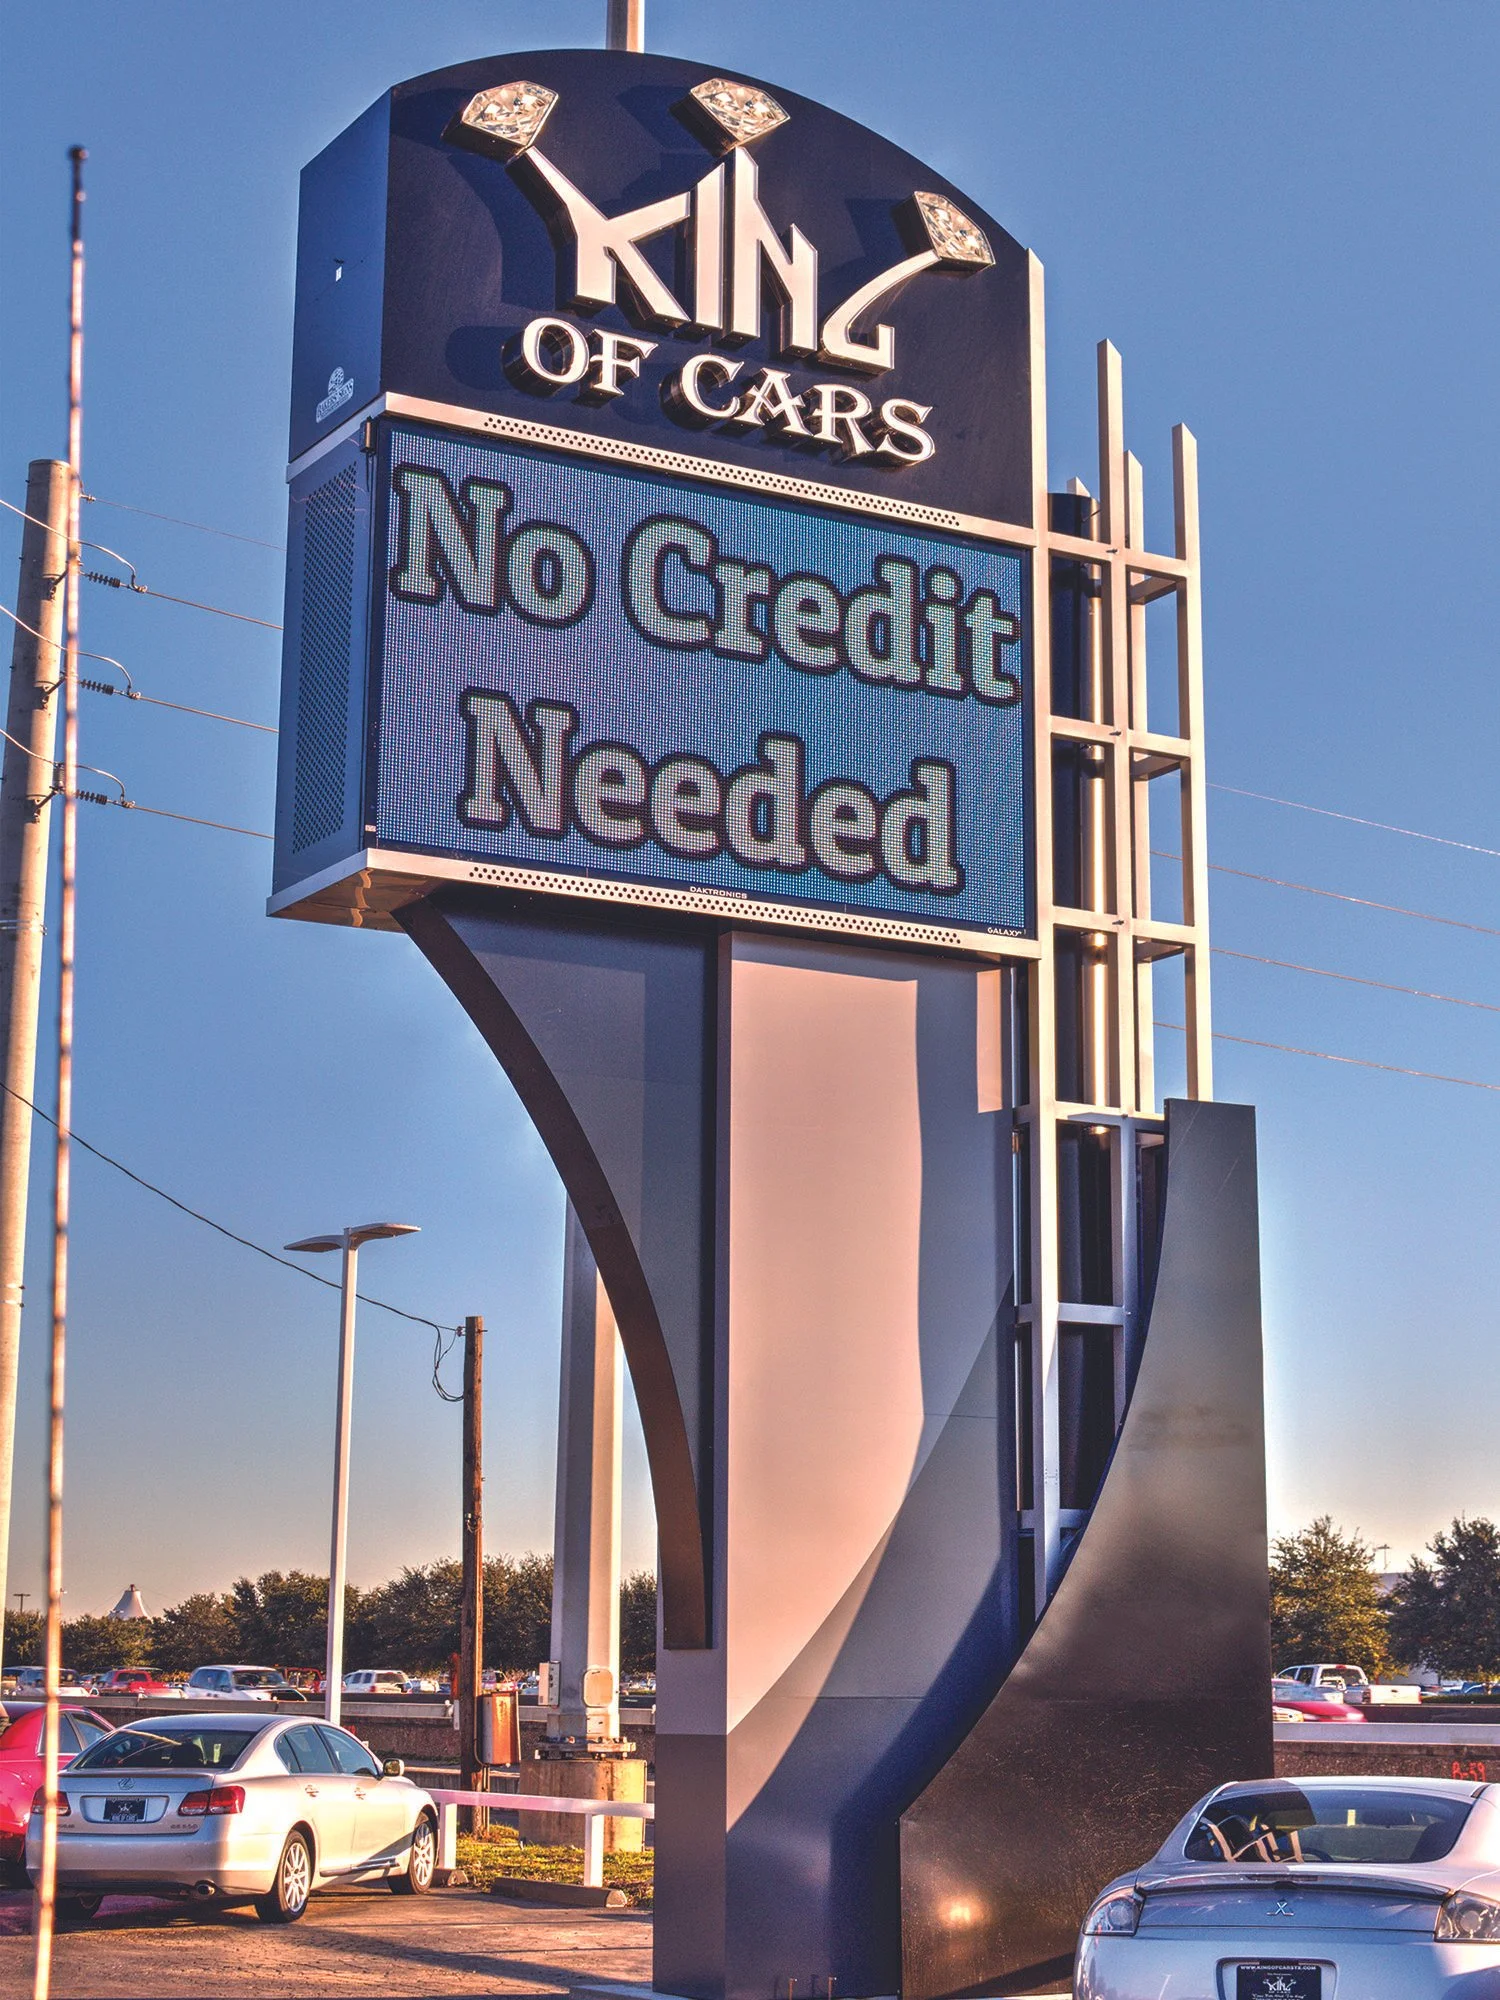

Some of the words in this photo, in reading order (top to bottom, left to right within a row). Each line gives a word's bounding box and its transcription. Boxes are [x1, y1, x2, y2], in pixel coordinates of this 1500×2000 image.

[525, 145, 943, 371] KING
[521, 316, 659, 396] OF
[681, 353, 936, 466] CARS
[392, 464, 594, 627] No
[625, 516, 1020, 705] Credit
[459, 688, 963, 895] Needed
[689, 885, 748, 900] DAKTRONICS
